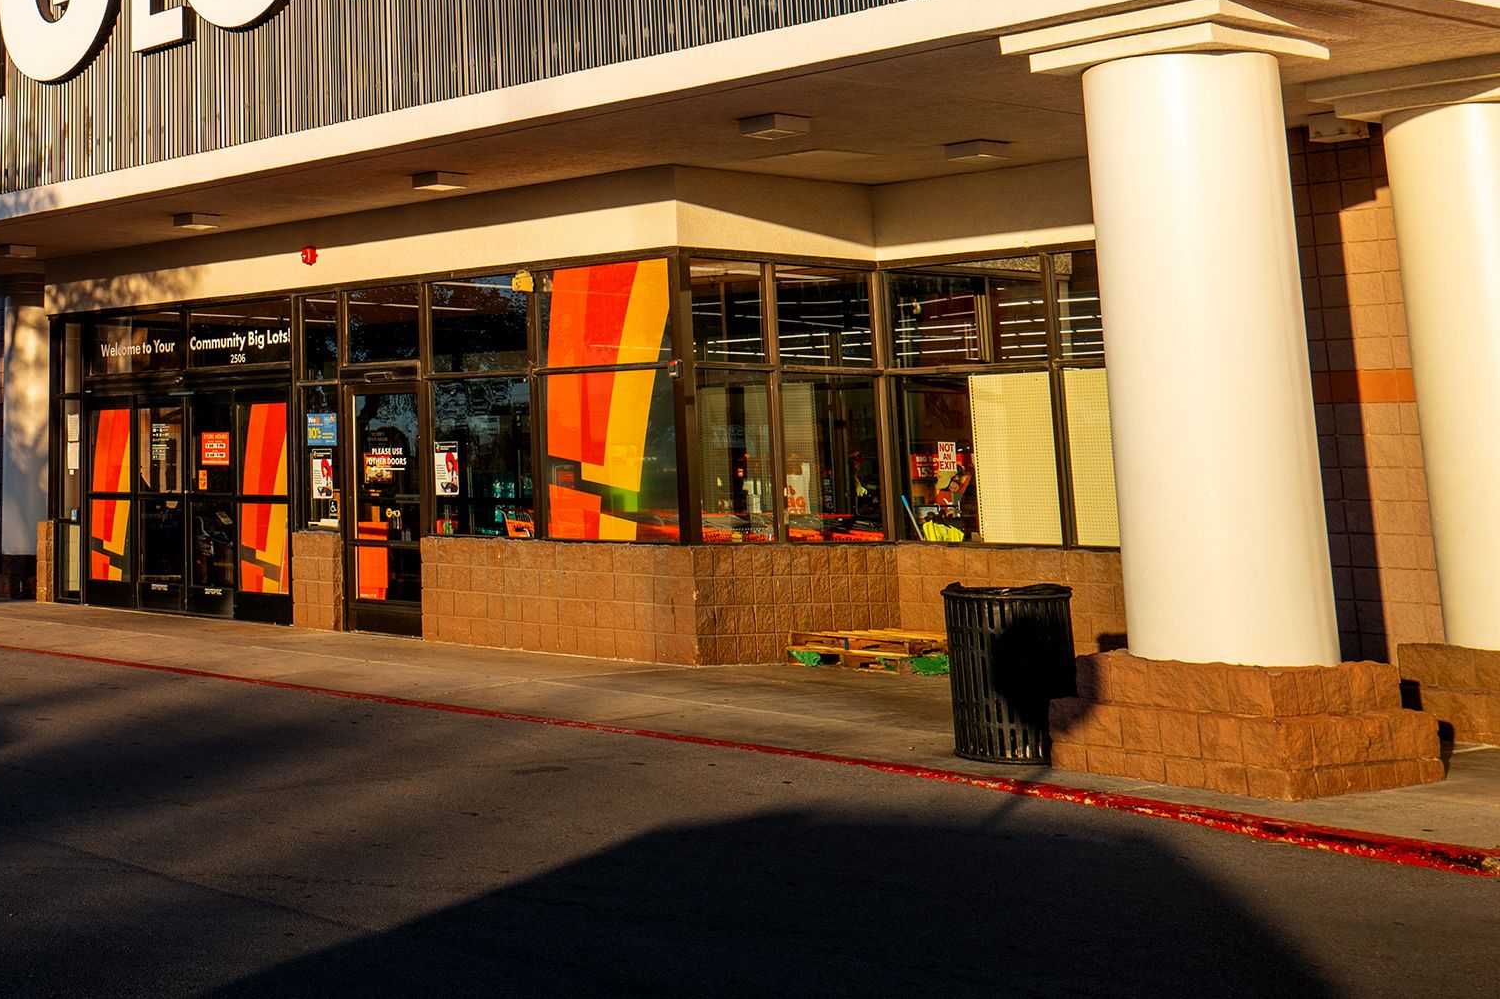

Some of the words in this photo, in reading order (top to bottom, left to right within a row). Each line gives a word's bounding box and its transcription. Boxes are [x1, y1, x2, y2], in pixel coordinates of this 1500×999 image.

[101, 342, 141, 357] Welcome
[142, 342, 152, 355] to
[153, 339, 175, 354] Your
[190, 331, 247, 352] Community
[248, 330, 265, 350] Big
[267, 327, 291, 345] Lots!
[230, 353, 246, 364] 2506
[371, 447, 391, 455] PLEASE
[392, 447, 403, 455] USE
[939, 443, 955, 452] NOT
[368, 457, 388, 466] OTHER
[388, 457, 407, 466] DOORS
[939, 461, 956, 470] EXIT
